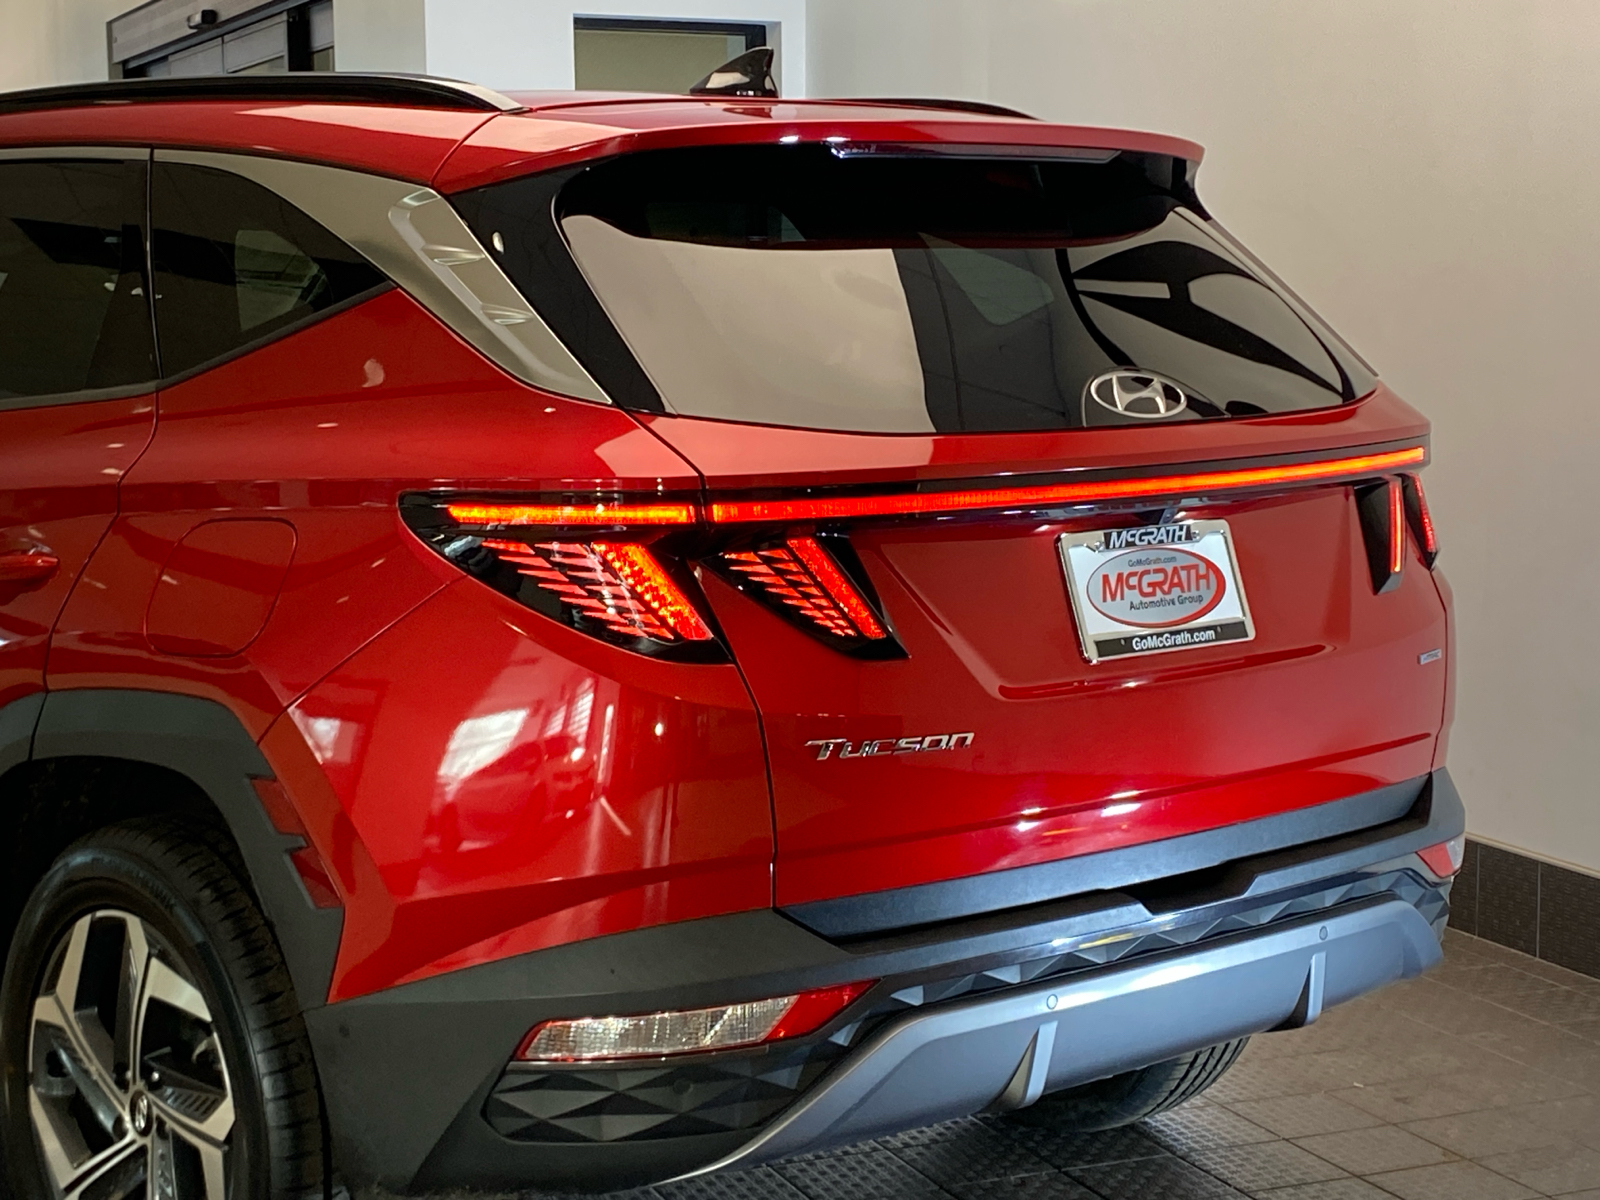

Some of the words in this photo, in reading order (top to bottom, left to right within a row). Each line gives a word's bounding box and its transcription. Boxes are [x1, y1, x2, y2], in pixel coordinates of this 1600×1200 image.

[1128, 556, 1177, 567] GoMcGrath.com
[1129, 598, 1176, 611] Automotive
[1177, 594, 1204, 605] Group
[1132, 630, 1215, 651] GoMcGrath.com
